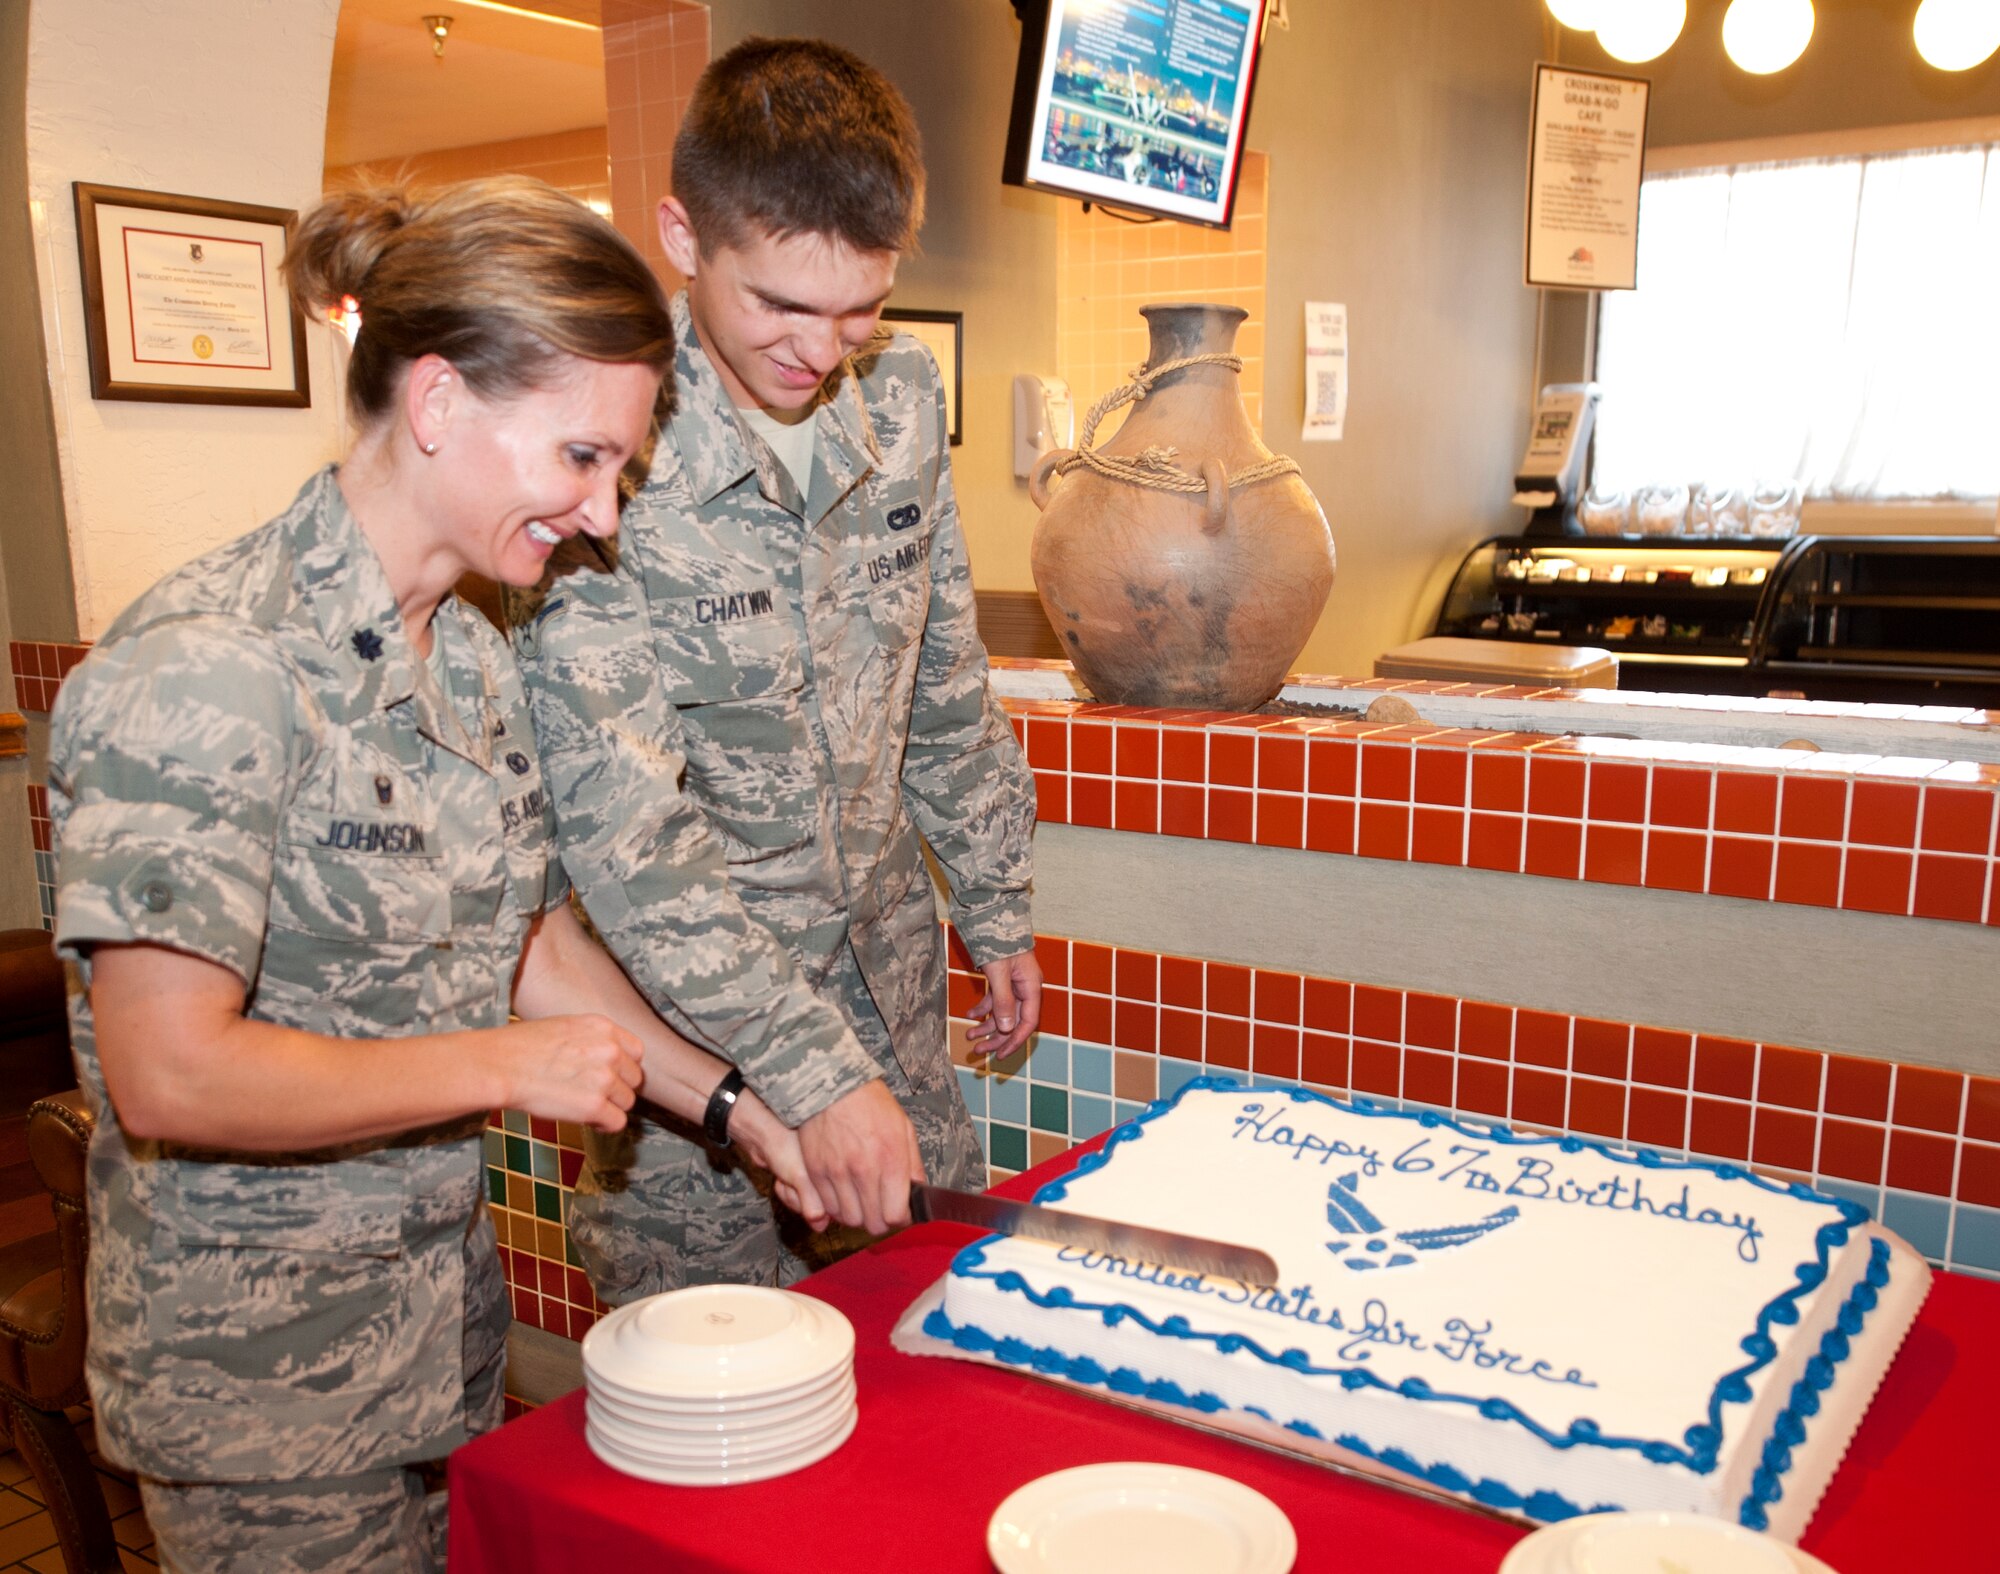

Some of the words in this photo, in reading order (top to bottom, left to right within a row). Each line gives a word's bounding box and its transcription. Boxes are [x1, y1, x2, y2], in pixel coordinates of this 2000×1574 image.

[1564, 77, 1622, 96] CROSSWINDS
[1577, 109, 1602, 123] CAFE
[896, 542, 919, 572] AIR
[695, 589, 774, 624] CHATWIN
[316, 819, 426, 853] JOHNSON
[1231, 1103, 1385, 1178] Happy
[1504, 1156, 1764, 1264] Birthday
[1337, 1299, 1430, 1361] Air
[1433, 1317, 1599, 1389] Force
